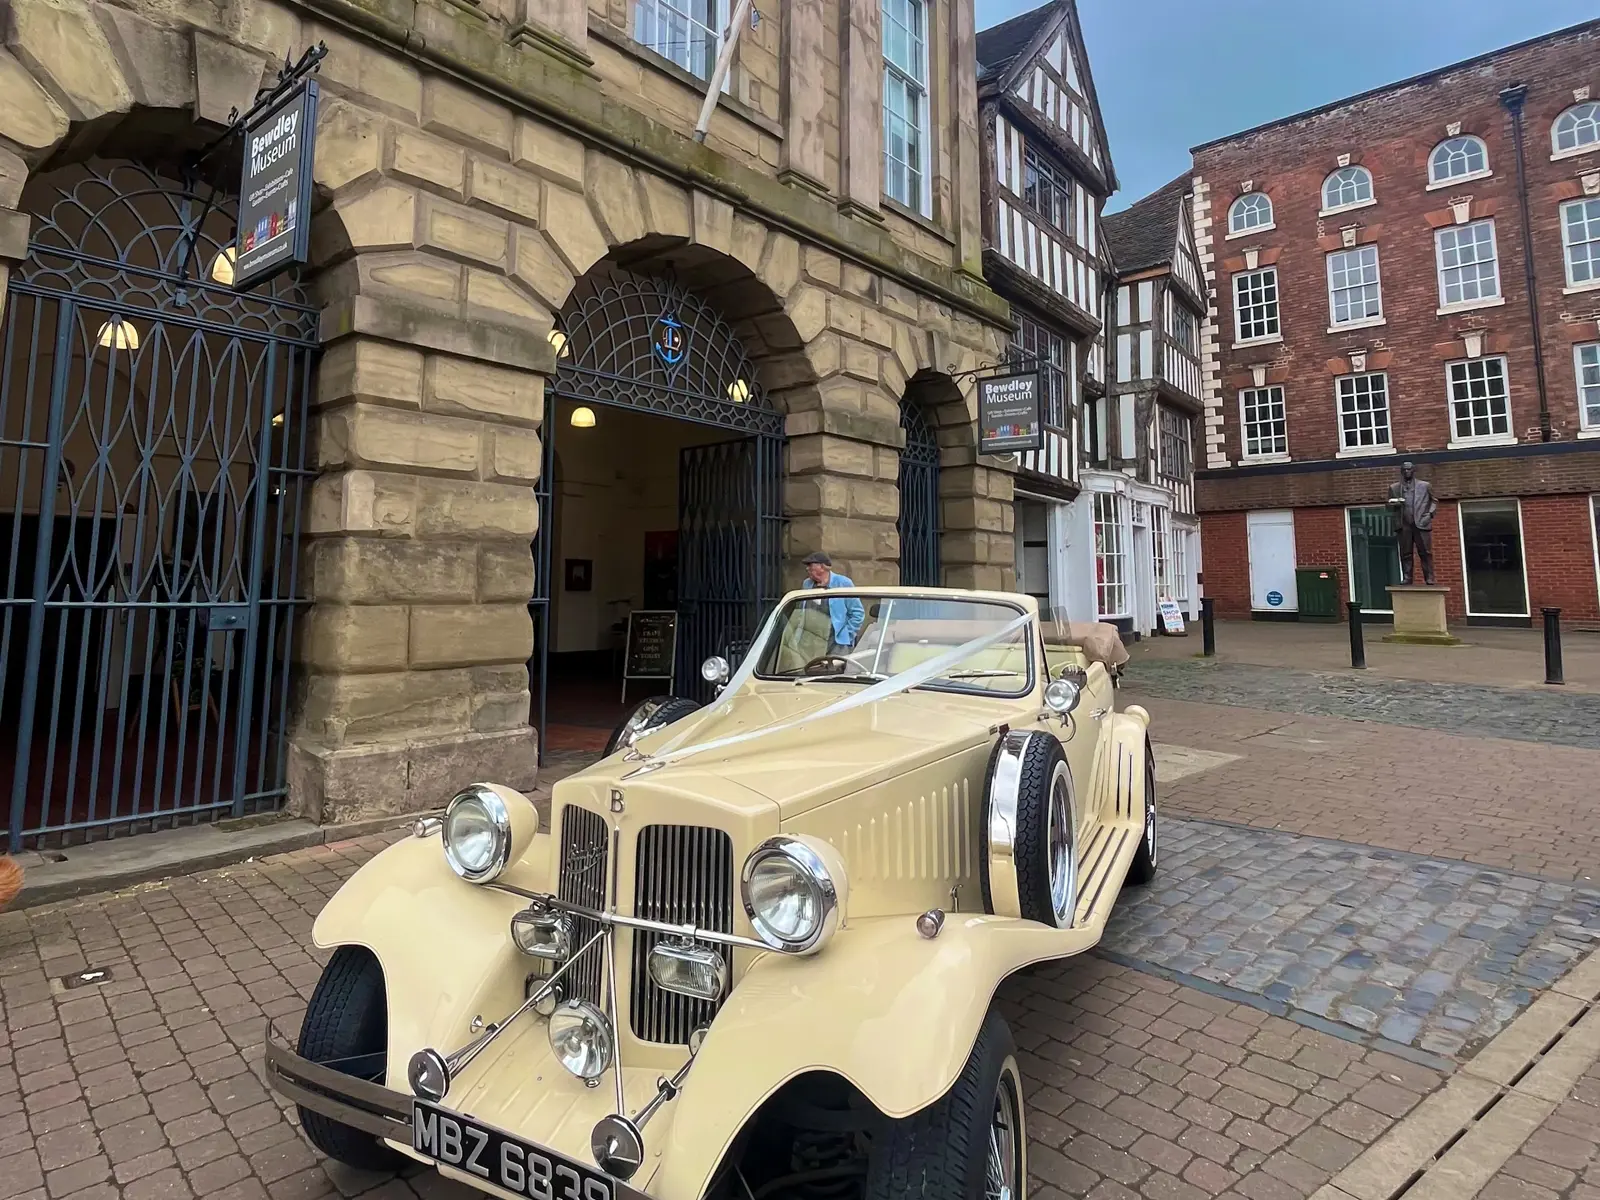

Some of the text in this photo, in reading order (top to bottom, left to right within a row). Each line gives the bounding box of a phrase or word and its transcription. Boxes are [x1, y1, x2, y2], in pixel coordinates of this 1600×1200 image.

[251, 110, 299, 158] Bewdley
[250, 133, 296, 178] Museum
[985, 380, 1033, 394] Bewdley
[986, 390, 1032, 404] Museum
[610, 789, 625, 813] B
[415, 1107, 489, 1177] MBZ
